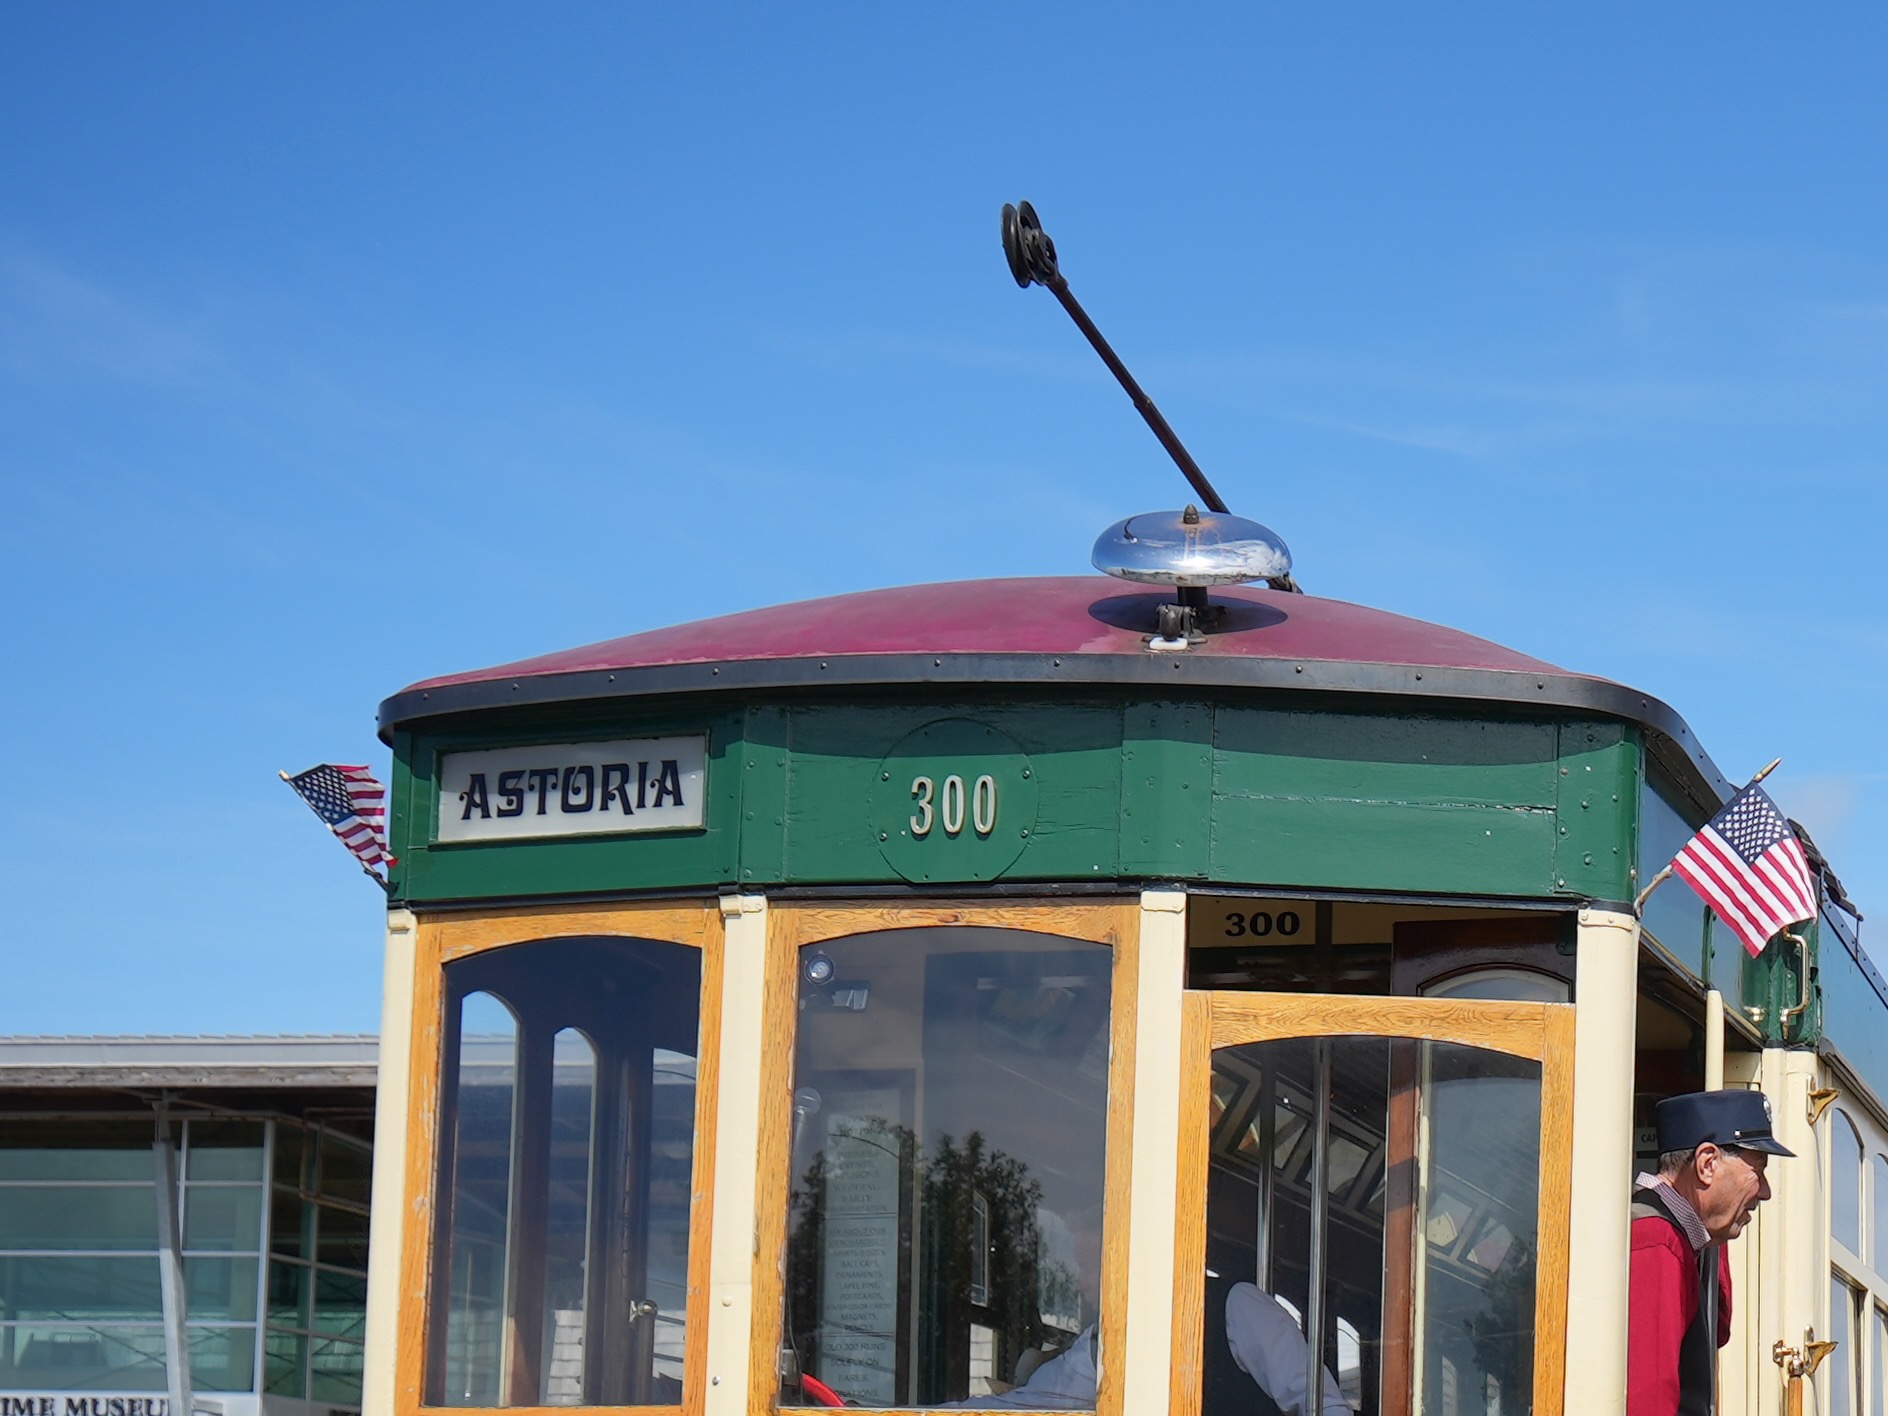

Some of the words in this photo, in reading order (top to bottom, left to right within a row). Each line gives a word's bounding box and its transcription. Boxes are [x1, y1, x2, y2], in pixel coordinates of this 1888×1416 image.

[459, 760, 684, 820] ASTORIA
[910, 774, 997, 834] 300
[1225, 911, 1300, 937] 300
